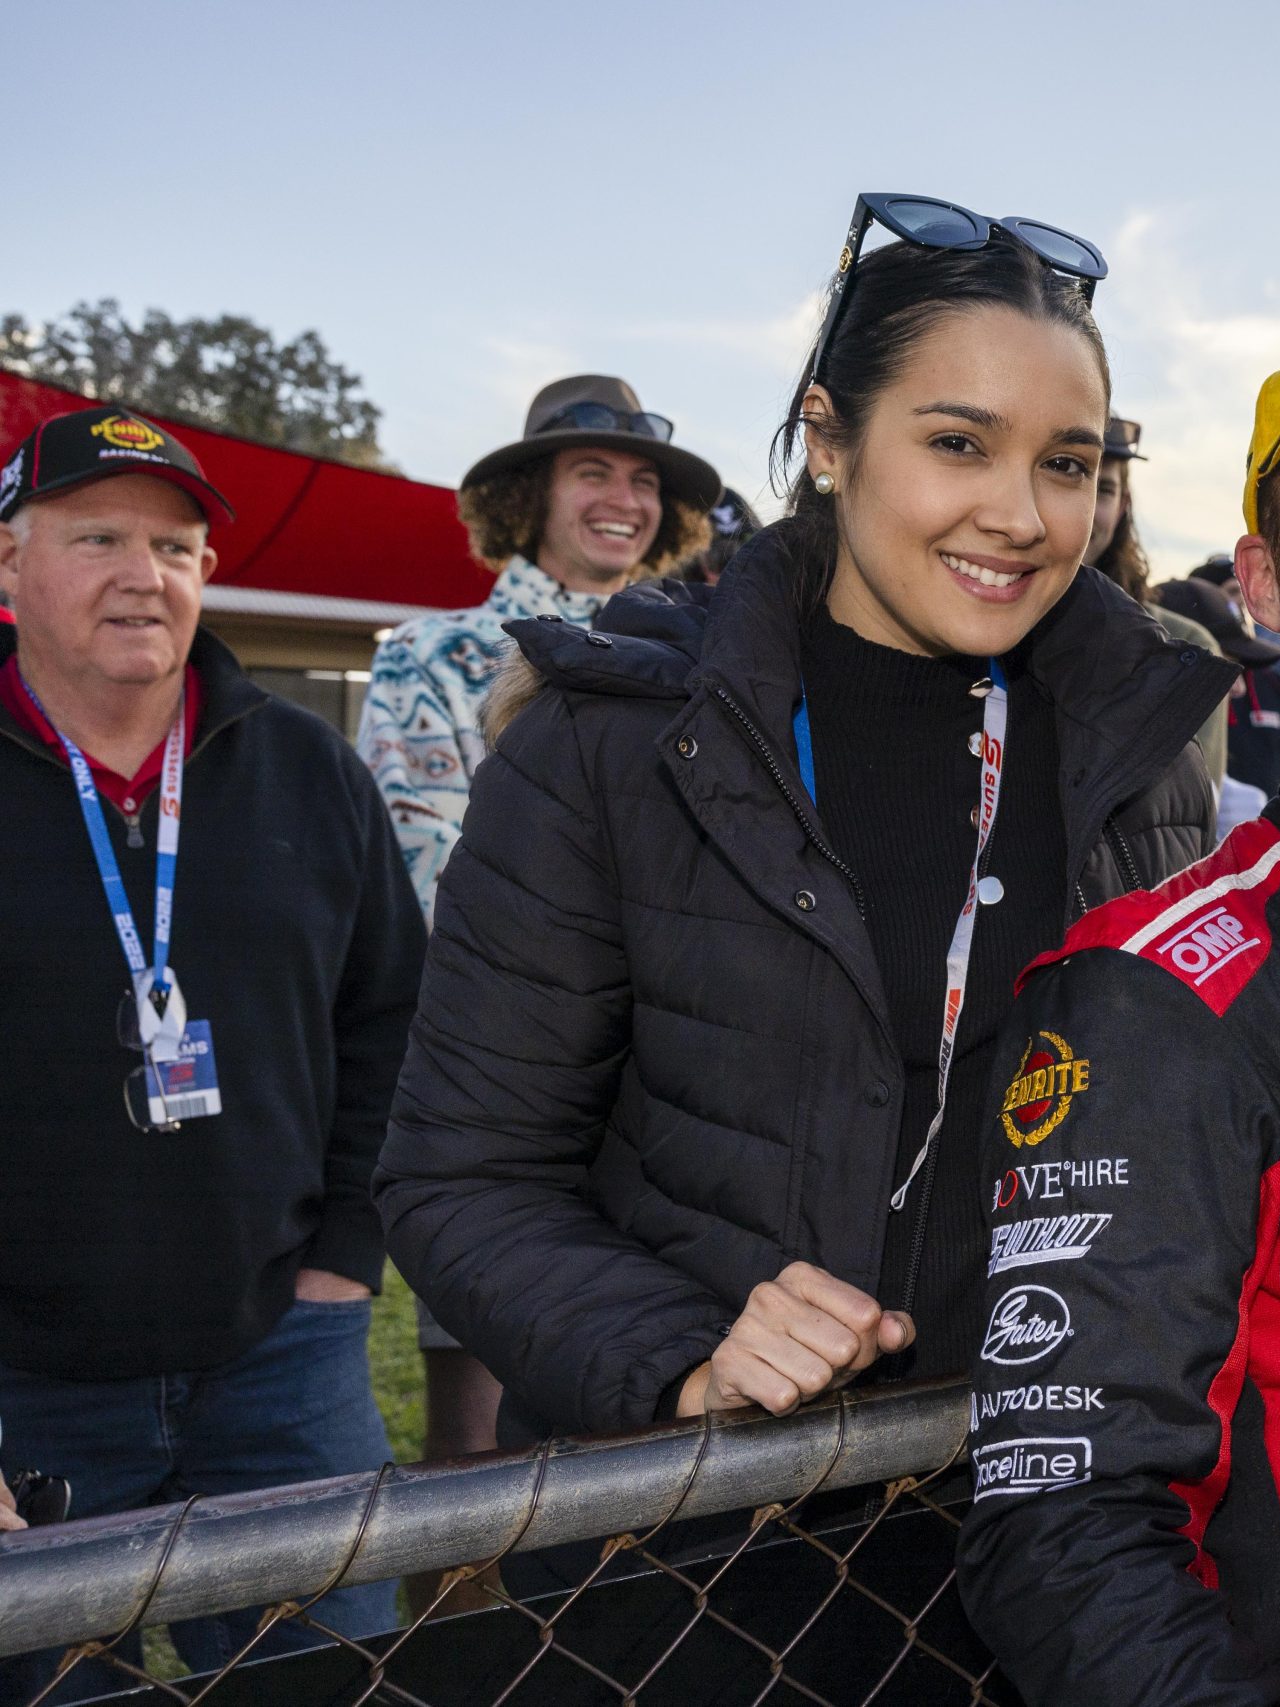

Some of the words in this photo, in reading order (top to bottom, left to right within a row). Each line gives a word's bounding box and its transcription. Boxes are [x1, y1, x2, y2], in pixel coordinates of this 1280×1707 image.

[114, 913, 147, 970] 2022
[1171, 914, 1246, 973] OMP
[1071, 1158, 1129, 1187] HIRE
[980, 1385, 1106, 1420] AUTODESK
